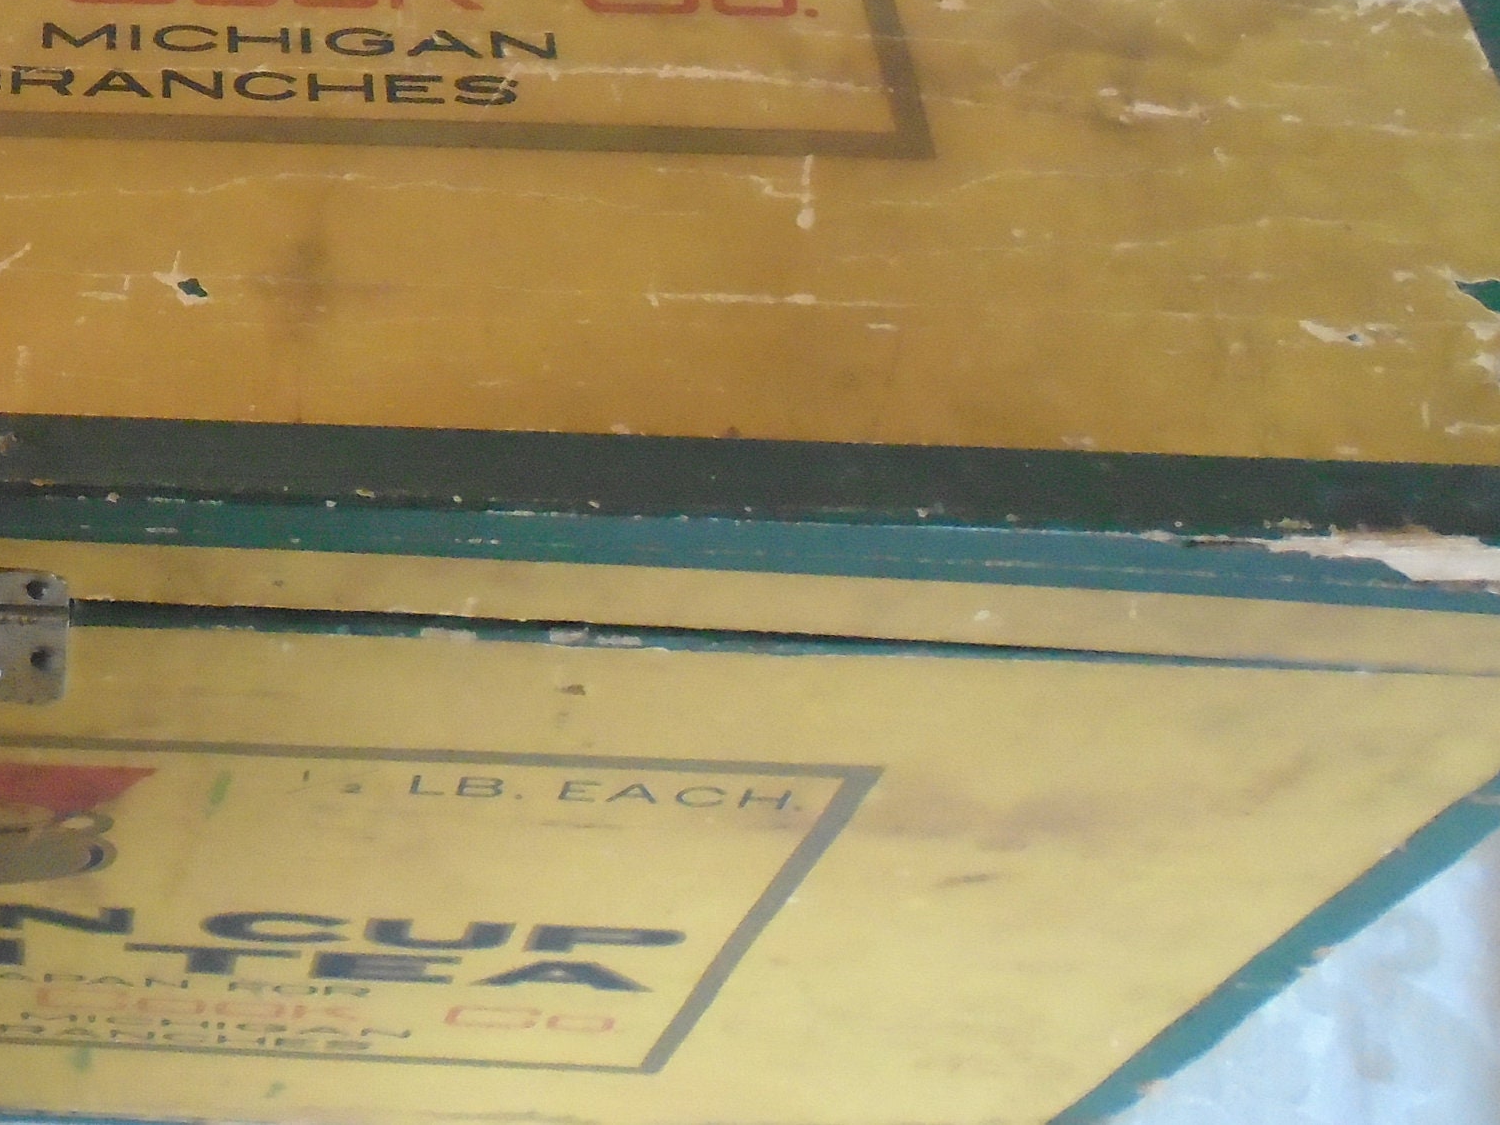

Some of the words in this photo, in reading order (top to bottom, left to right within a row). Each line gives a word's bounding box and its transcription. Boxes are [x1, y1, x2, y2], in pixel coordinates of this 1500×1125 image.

[41, 21, 559, 61] MICHIGAN
[409, 774, 524, 802] LB.
[200, 910, 686, 952] CUP
[123, 942, 654, 994] TEA
